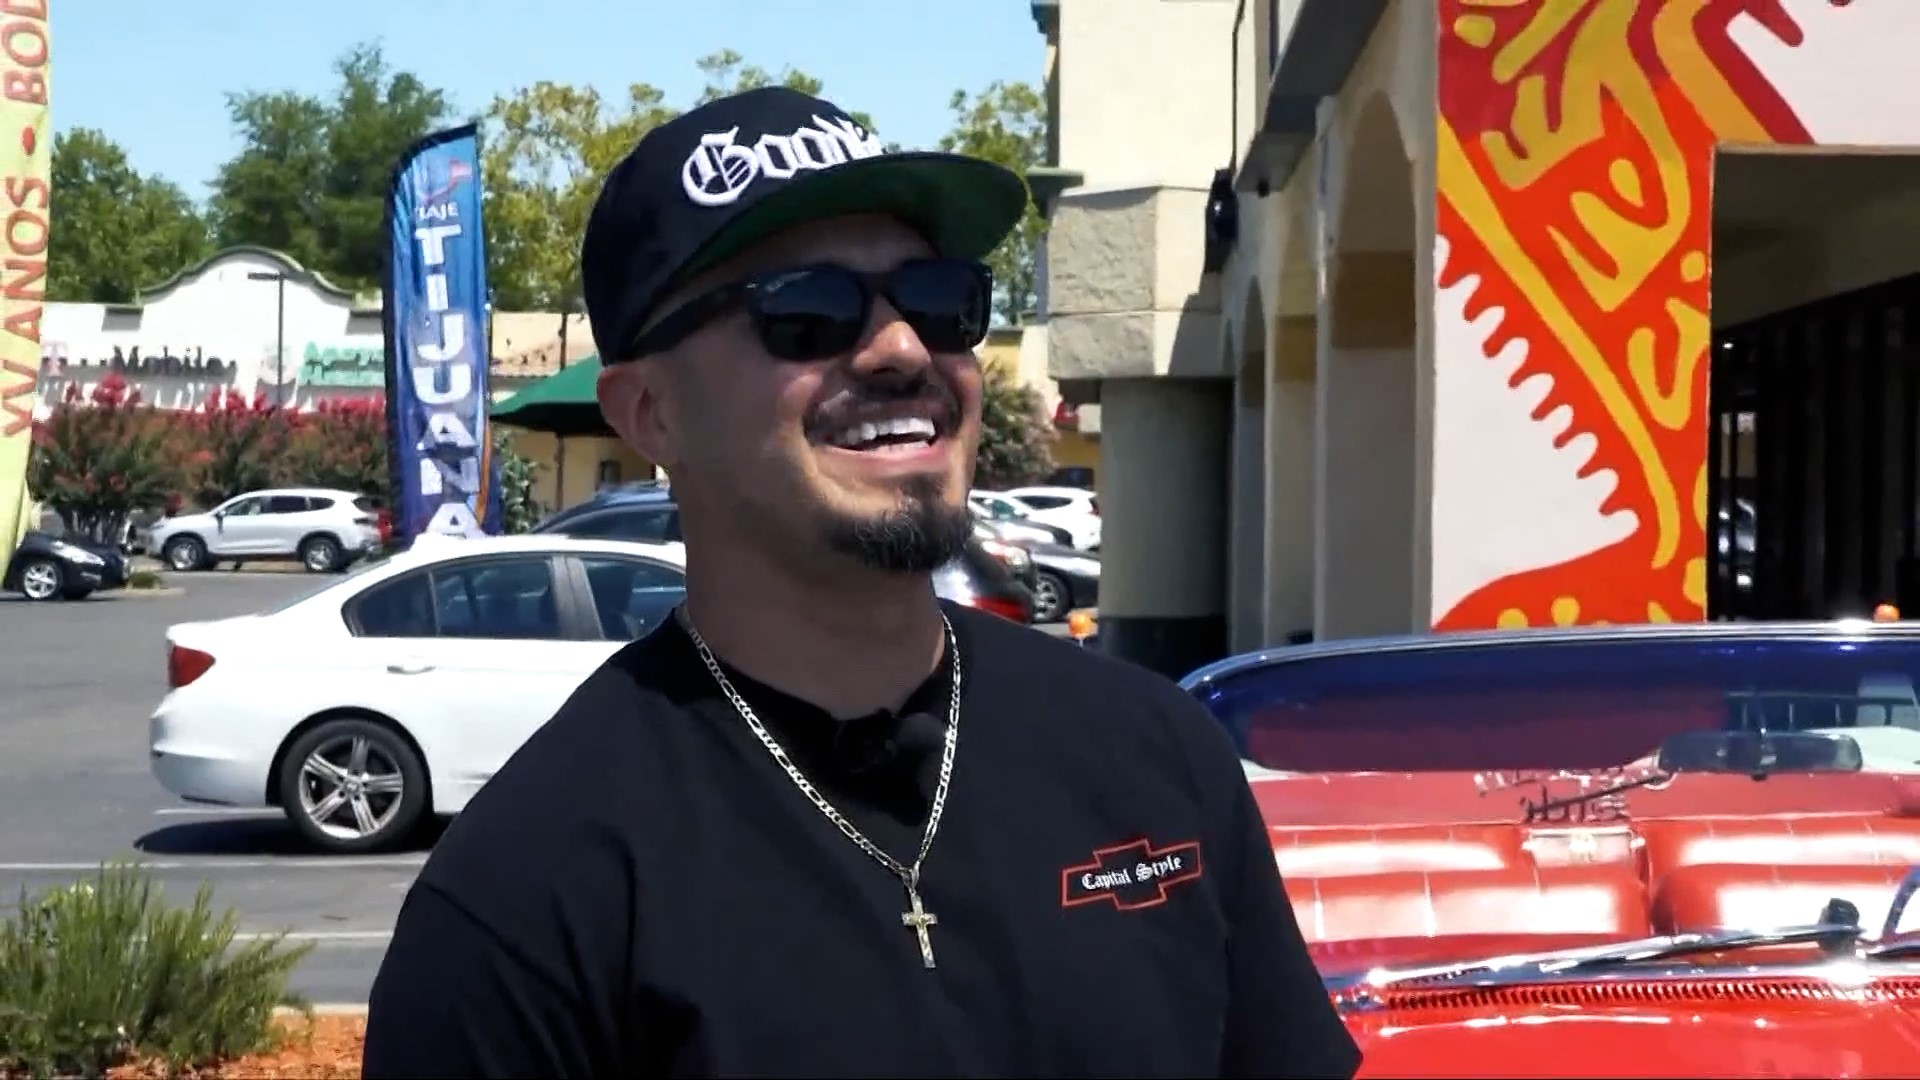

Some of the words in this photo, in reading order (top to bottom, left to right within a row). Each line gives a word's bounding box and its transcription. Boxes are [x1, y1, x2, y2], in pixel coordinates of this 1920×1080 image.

[413, 224, 486, 538] TIJUANA
[1081, 868, 1132, 890] Capital
[1136, 854, 1183, 882] Style
